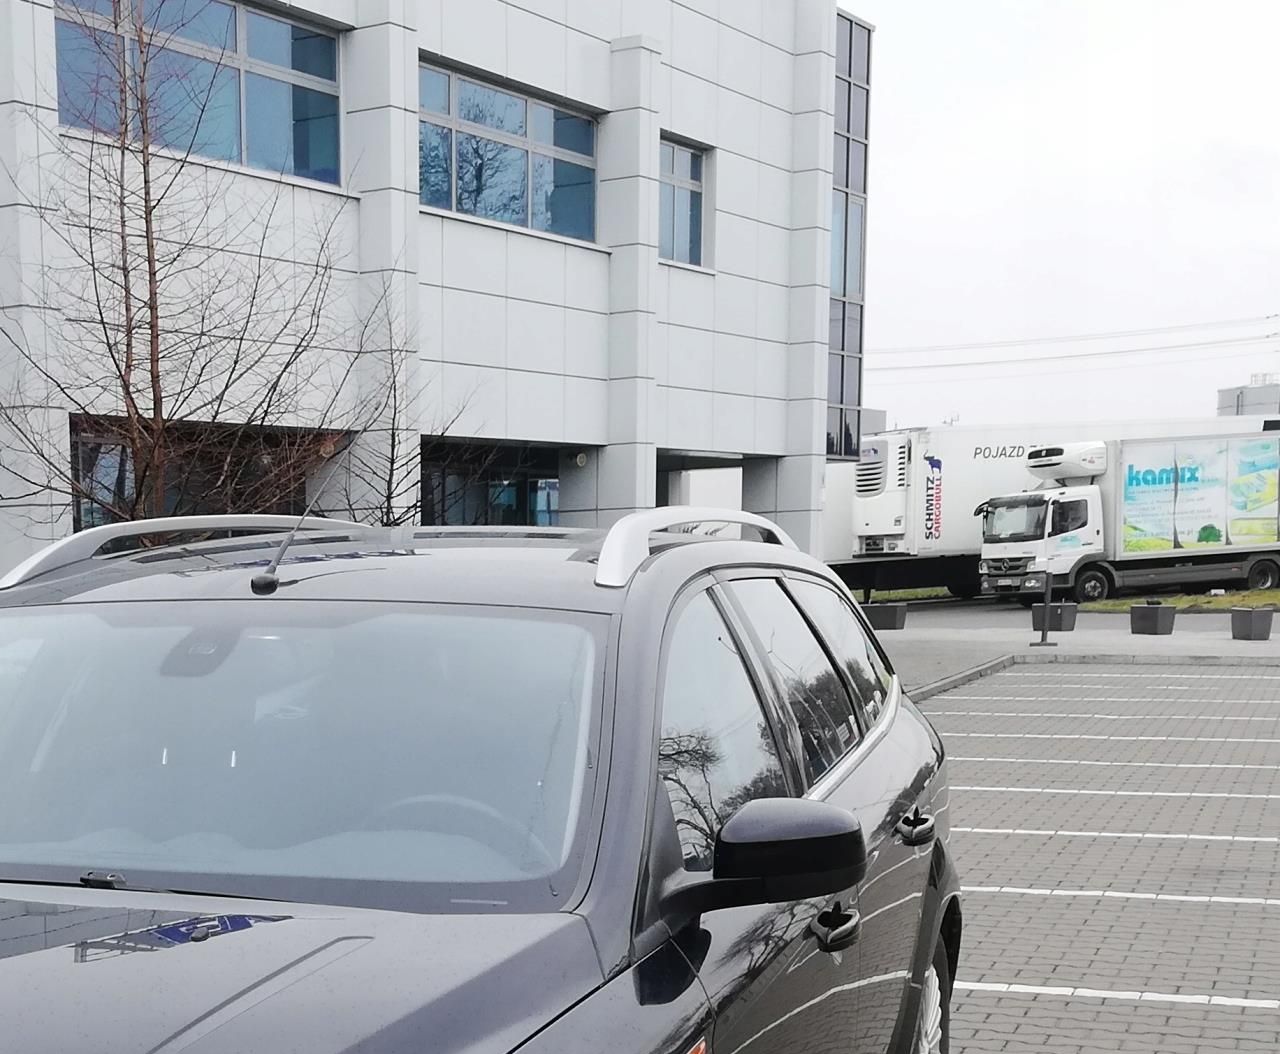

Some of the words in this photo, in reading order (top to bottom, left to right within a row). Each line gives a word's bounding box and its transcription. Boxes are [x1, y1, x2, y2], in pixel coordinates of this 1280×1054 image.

[973, 446, 1025, 459] POJAZD
[1127, 464, 1199, 487] kamix
[925, 476, 935, 540] SCHMITZ
[934, 475, 943, 540] CARGOBULL
